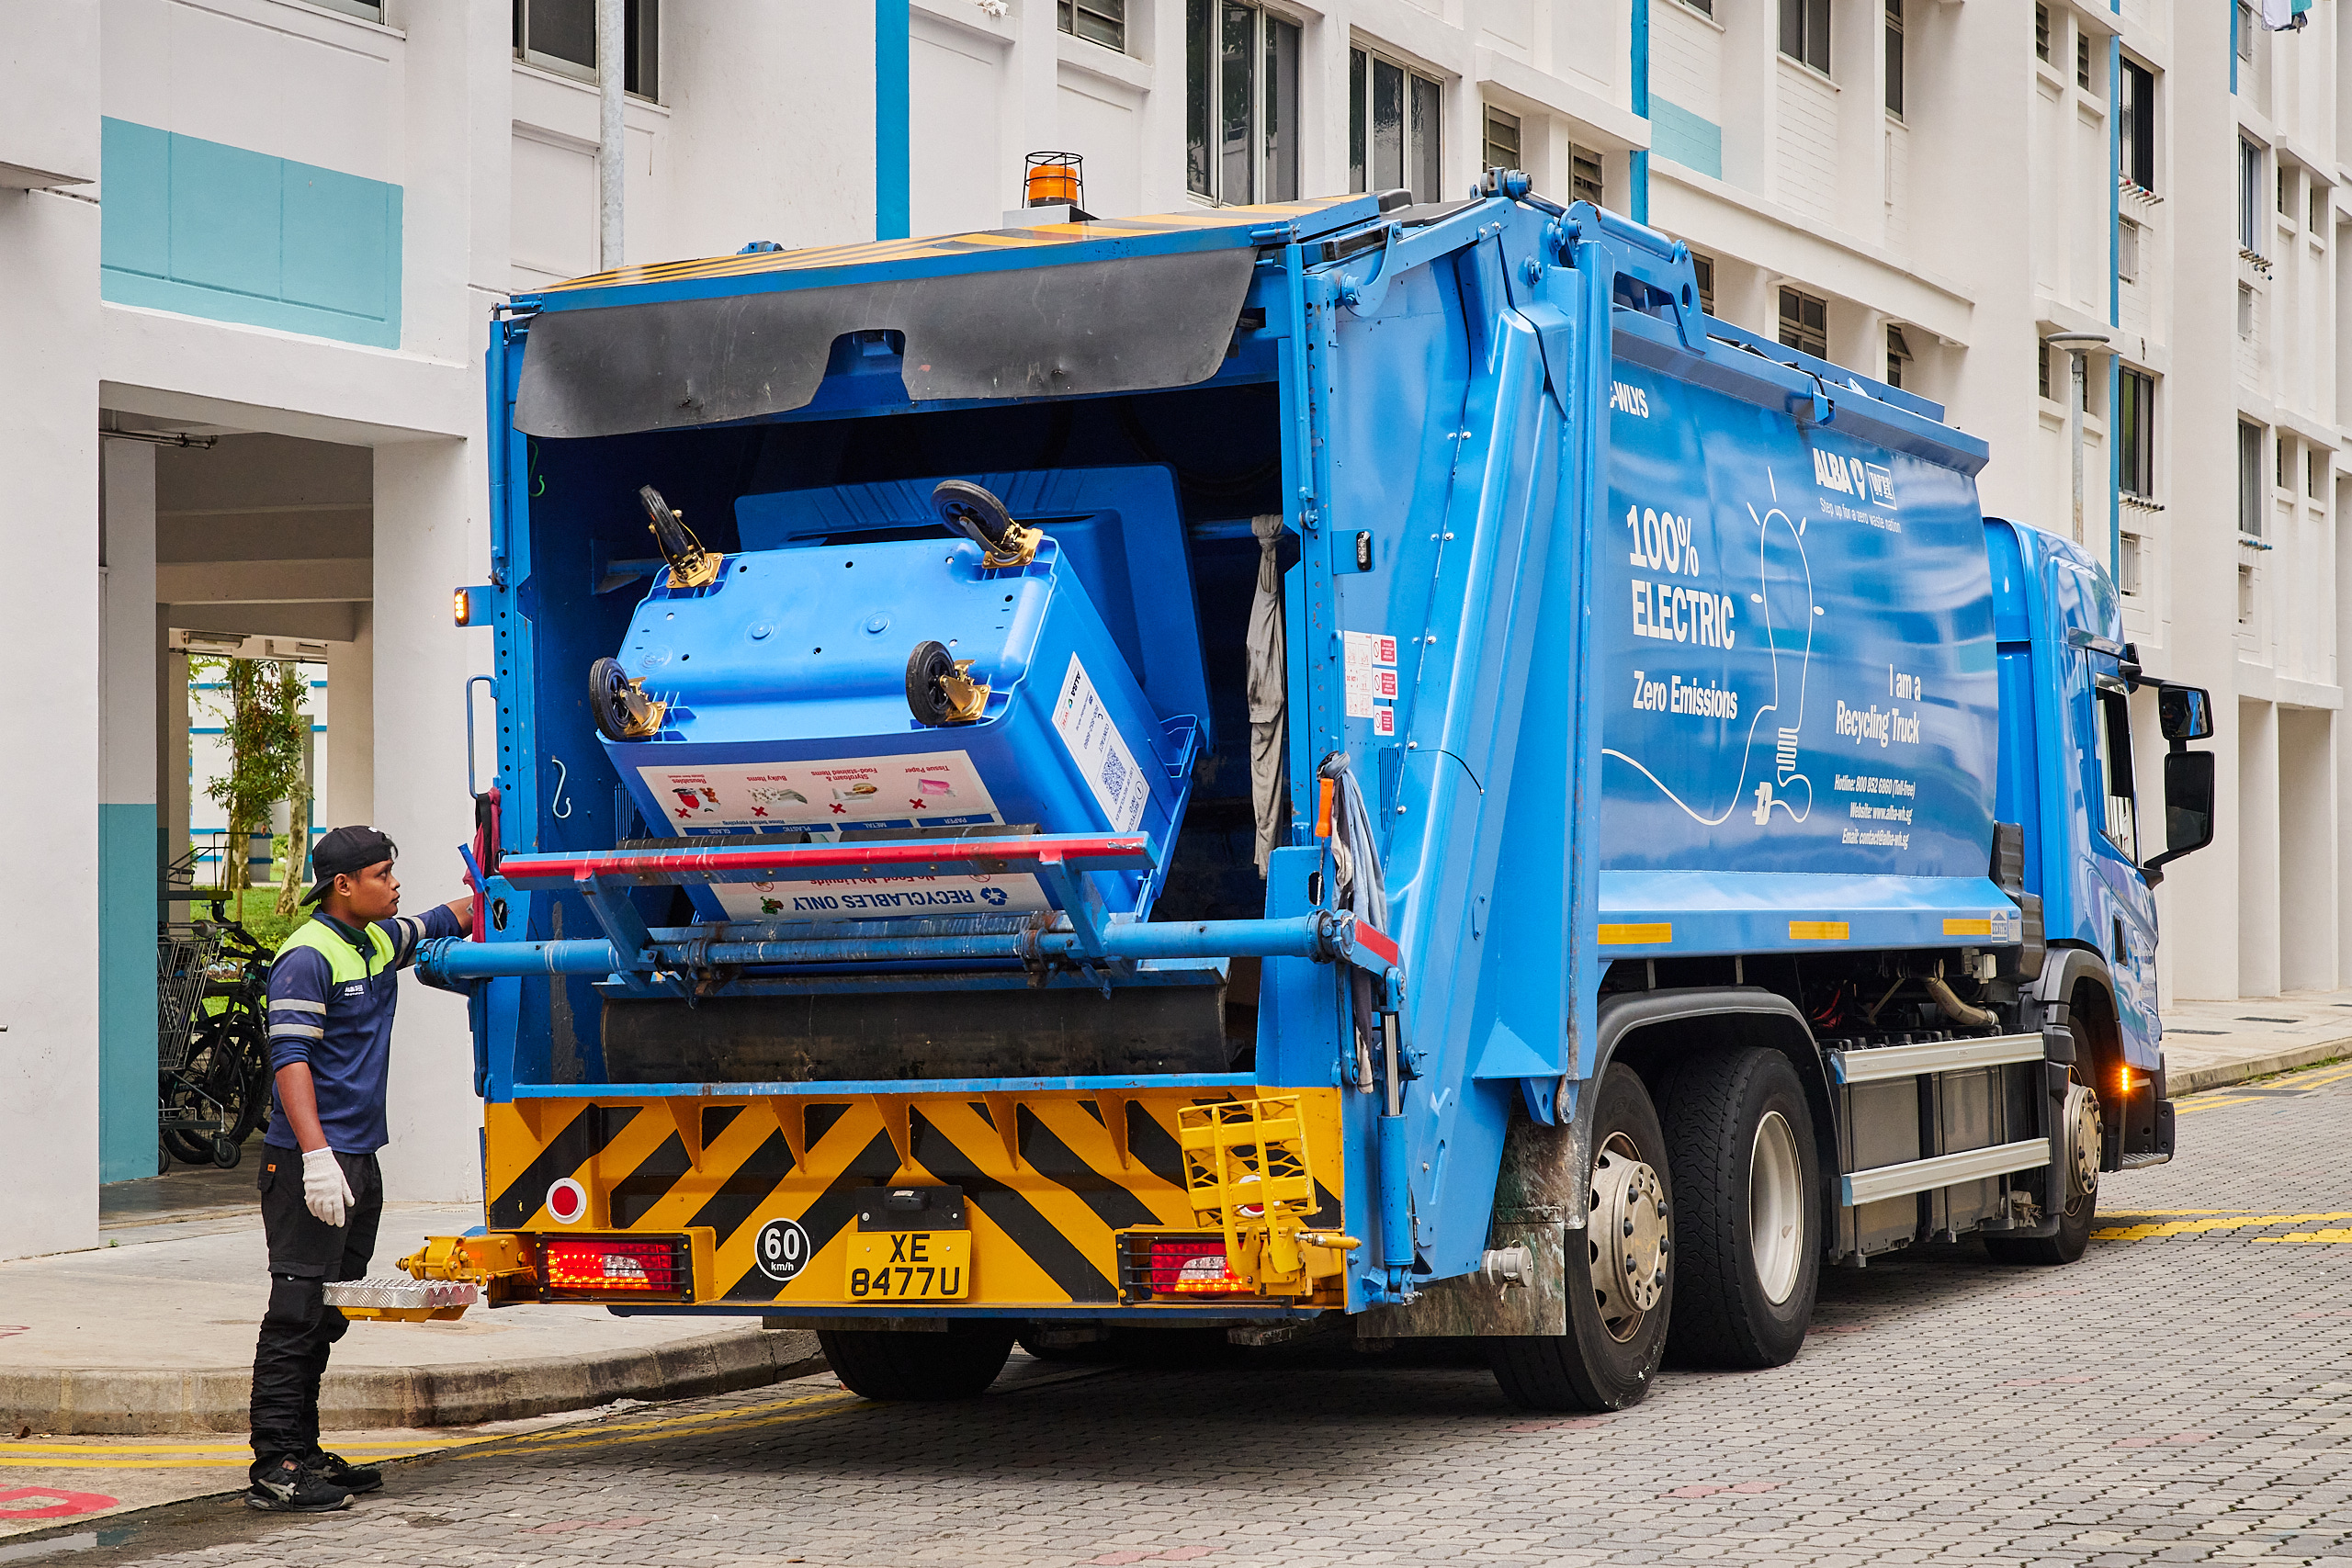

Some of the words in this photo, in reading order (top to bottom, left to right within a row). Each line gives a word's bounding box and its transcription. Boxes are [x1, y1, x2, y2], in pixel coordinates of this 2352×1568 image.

[1813, 447, 1854, 495] ALBA
[1819, 497, 1834, 517] Step
[1834, 504, 1842, 520] up
[1841, 503, 1851, 519] for
[1851, 509, 1856, 521] a
[1856, 511, 1869, 525] zero
[1869, 514, 1884, 529] waste
[1884, 518, 1902, 534] nation
[1626, 504, 1699, 577] 100%
[1631, 579, 1735, 650] ELECTRIC
[1633, 670, 1667, 712] Zero
[1670, 674, 1738, 720] Emissions
[1889, 663, 1894, 696] I
[1895, 672, 1912, 700] am
[1914, 676, 1921, 702] a
[1836, 699, 1890, 748] Recycling
[1892, 707, 1920, 744] Truck
[1834, 773, 1856, 791] Hotline:
[1856, 775, 1867, 792] 800
[1867, 776, 1878, 793] 852
[1849, 801, 1872, 819] Website:
[1841, 828, 1860, 844] Email:
[793, 895, 839, 911] ONLY
[841, 889, 975, 908] RECYCLABLES
[764, 1227, 800, 1260] 60
[888, 1234, 931, 1263] XE
[771, 1261, 794, 1271] km/h
[851, 1266, 960, 1296] 8477U
